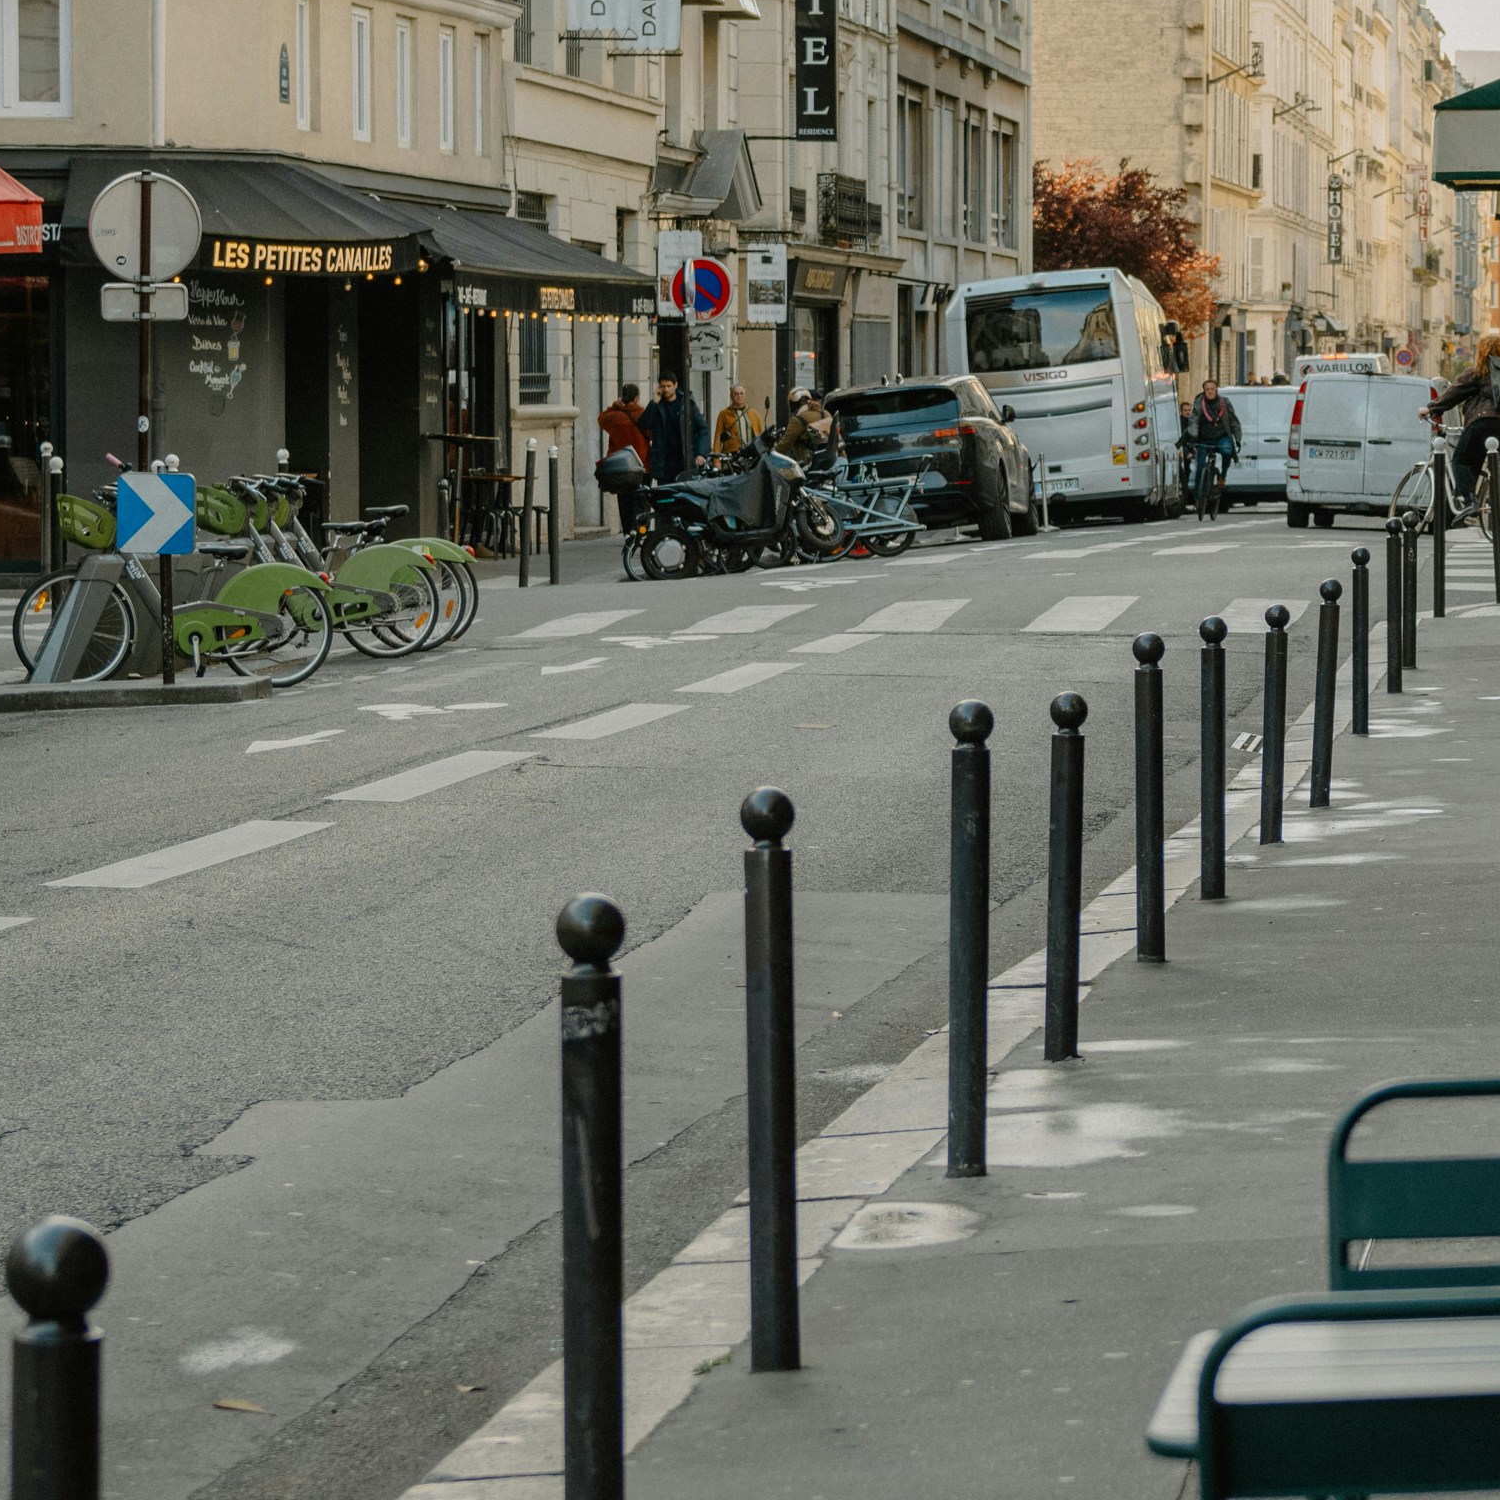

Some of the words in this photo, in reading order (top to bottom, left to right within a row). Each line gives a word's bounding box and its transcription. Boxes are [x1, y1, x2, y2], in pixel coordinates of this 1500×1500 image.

[798, 128, 835, 136] RESIDENCE
[1329, 191, 1341, 261] HOTEL
[213, 241, 250, 269] LES
[253, 244, 322, 272] PETITES
[326, 245, 392, 273] CANAILLES
[190, 280, 215, 307] Happy
[215, 288, 245, 306] Hour
[1023, 370, 1068, 382] VISIGO
[1316, 363, 1373, 373] VARILLON
